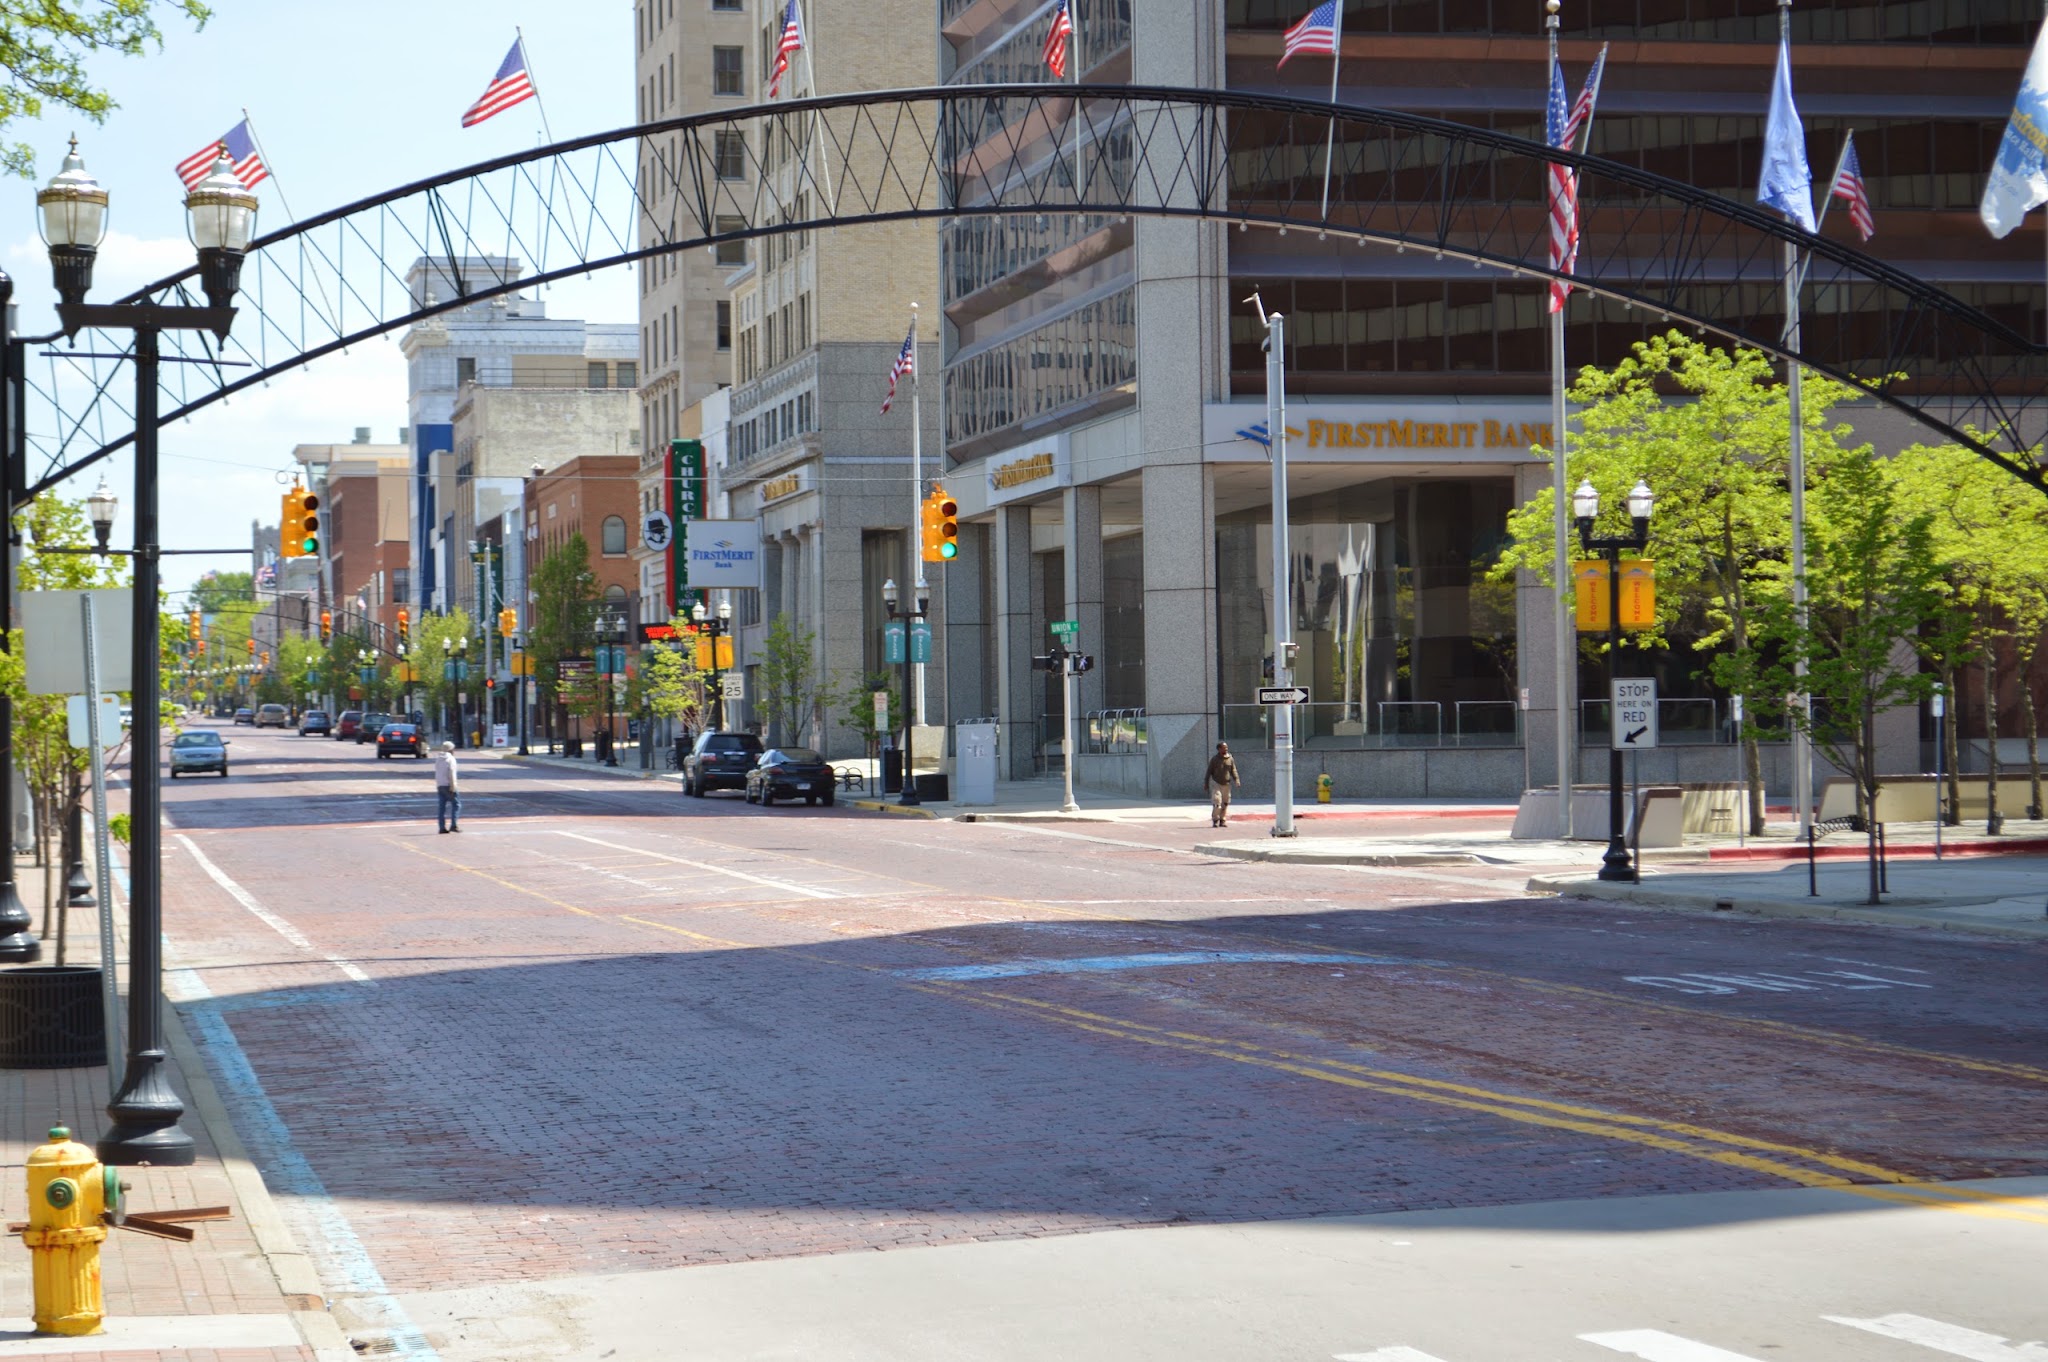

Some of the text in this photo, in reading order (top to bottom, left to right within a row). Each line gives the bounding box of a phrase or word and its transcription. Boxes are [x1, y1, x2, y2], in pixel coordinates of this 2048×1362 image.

[1307, 419, 1555, 448] FIRSTMERIT BANK
[693, 550, 755, 561] FIRSTMERIT
[1051, 622, 1072, 632] UNION
[726, 686, 742, 697] 25
[1619, 686, 1650, 697] STOP
[1617, 700, 1637, 708] HERE
[1623, 712, 1646, 722] RED
